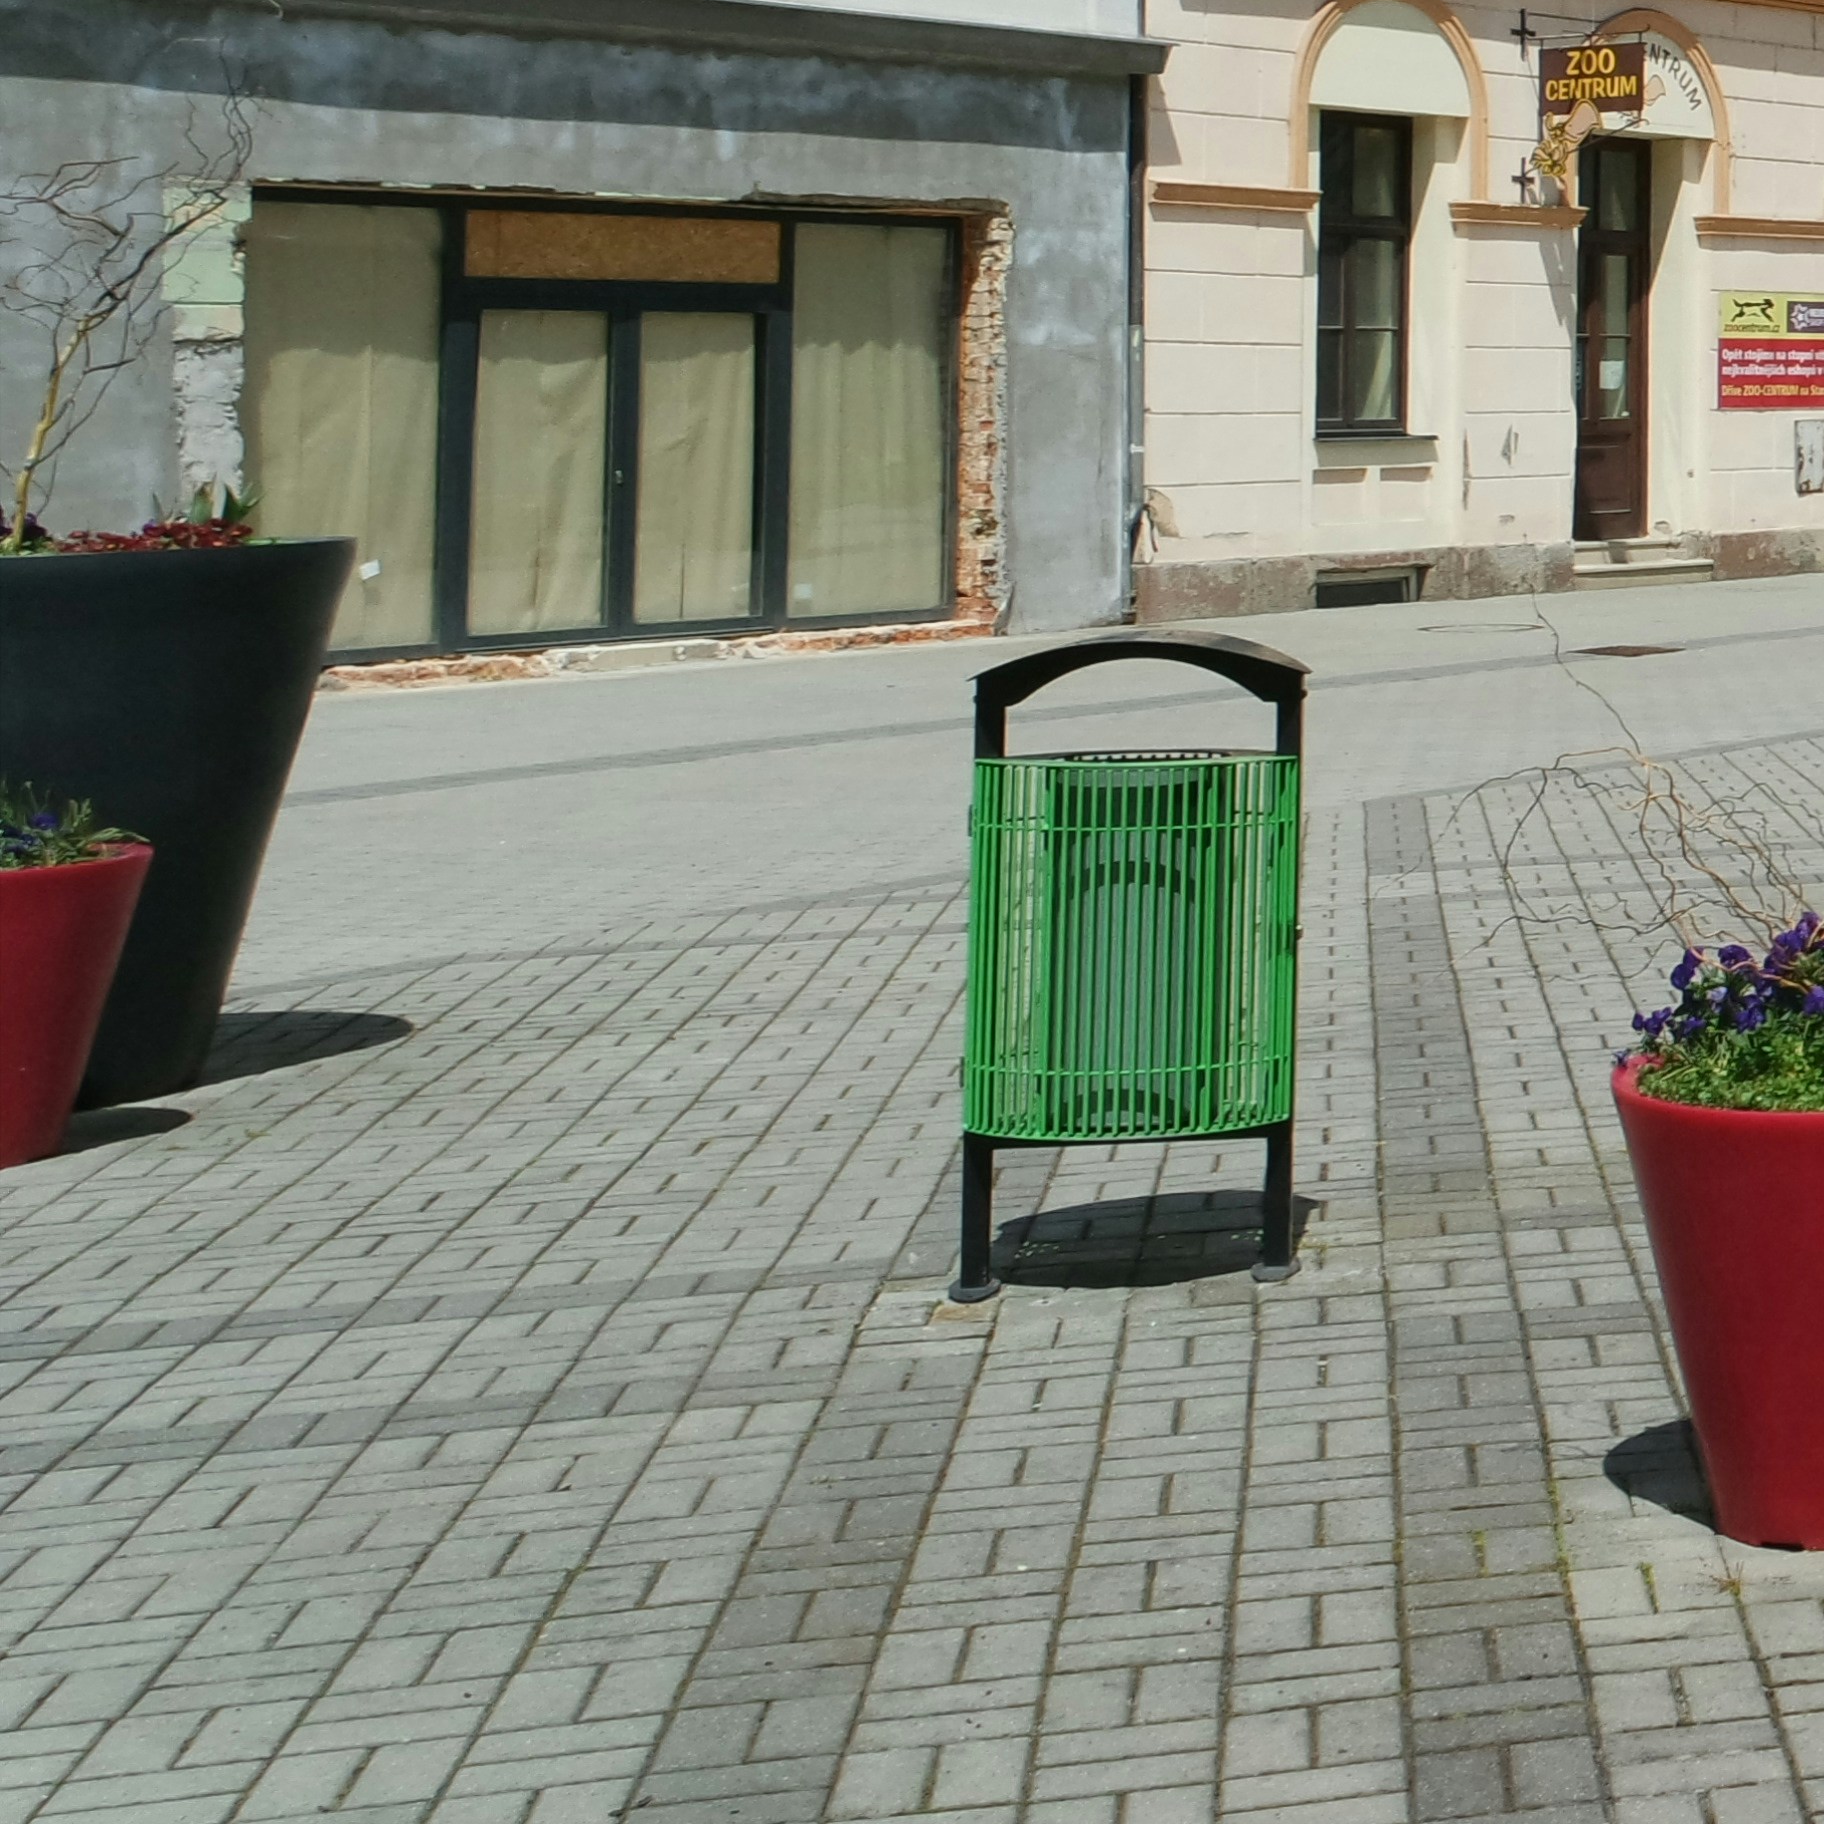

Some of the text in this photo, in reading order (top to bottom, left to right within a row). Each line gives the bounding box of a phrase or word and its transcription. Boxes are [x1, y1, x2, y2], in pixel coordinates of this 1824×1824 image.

[1566, 48, 1616, 75] ZOO
[1545, 76, 1637, 101] CENTRUM
[1723, 323, 1780, 333] zoocentrum.cz
